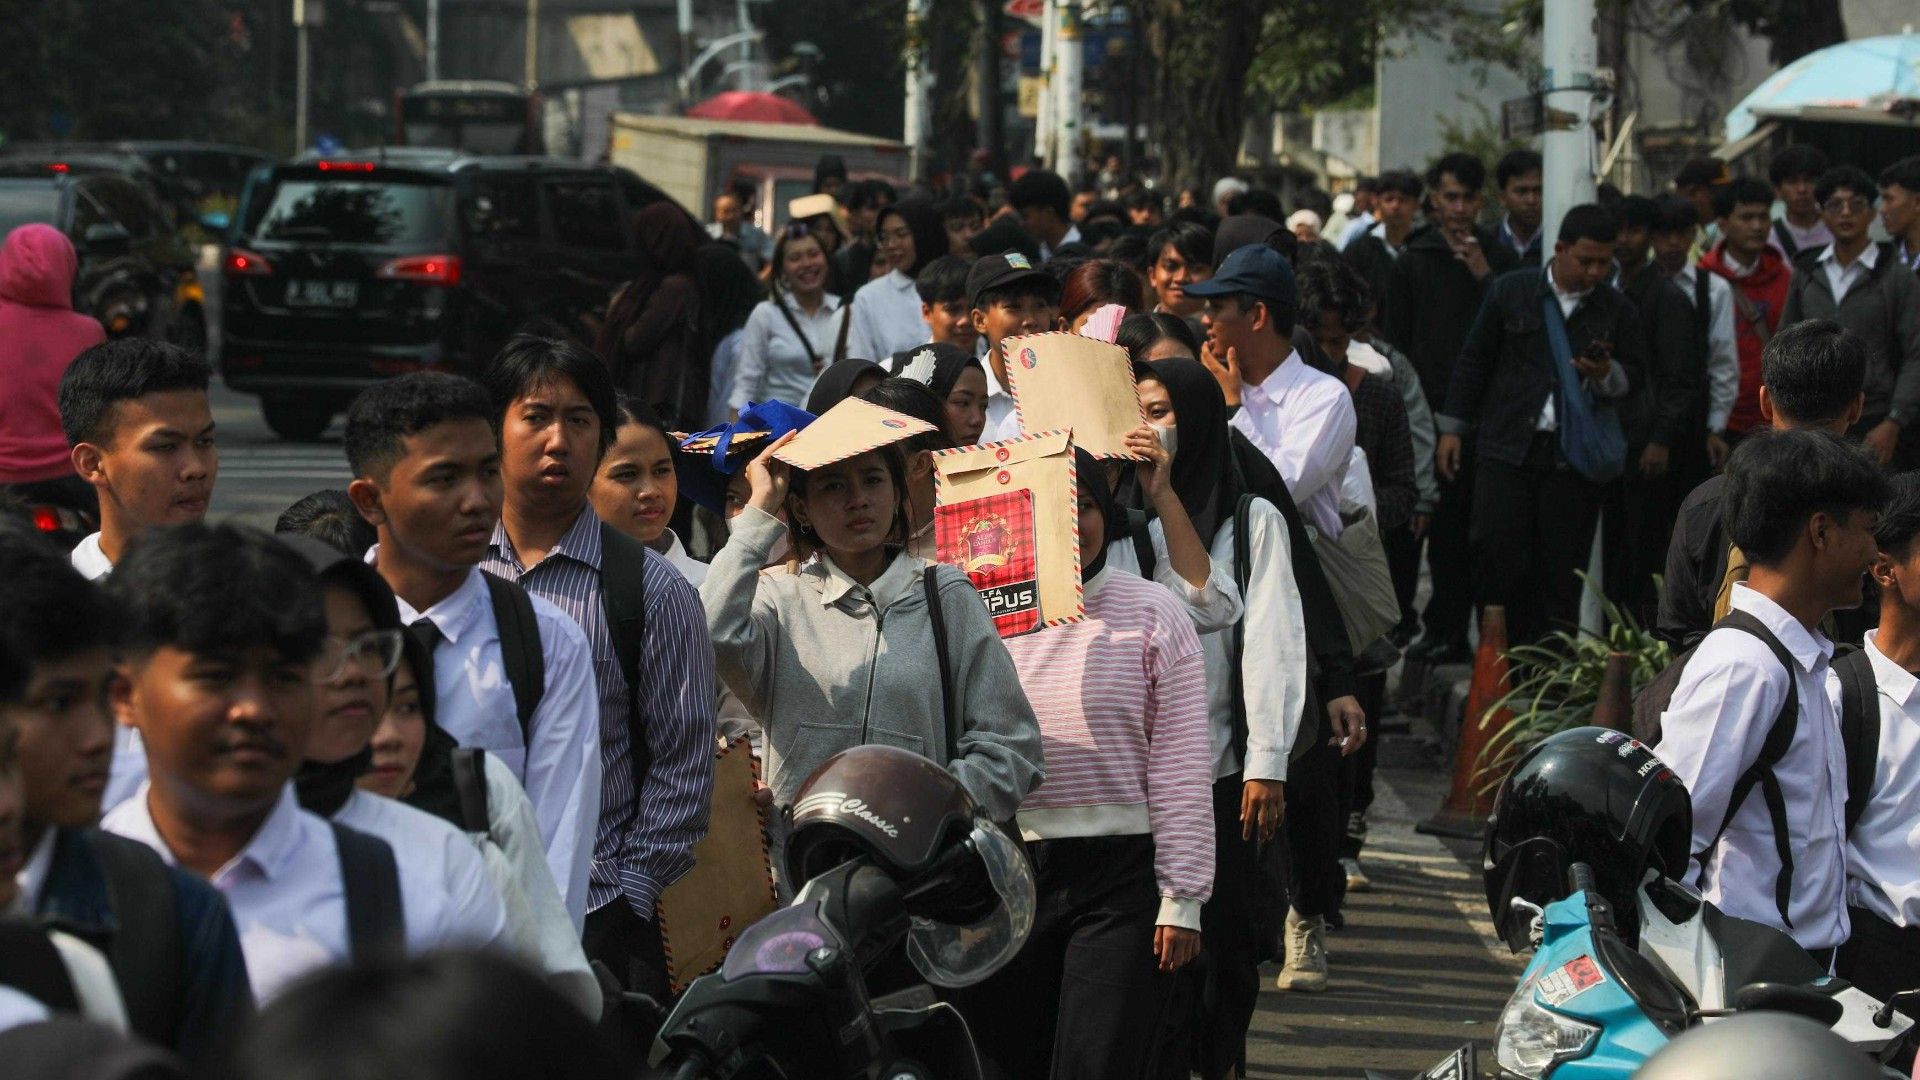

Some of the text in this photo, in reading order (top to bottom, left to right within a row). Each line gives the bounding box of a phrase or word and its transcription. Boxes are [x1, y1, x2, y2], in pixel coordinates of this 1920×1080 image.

[981, 588, 1002, 599] LFA
[984, 590, 1032, 612] PUS
[840, 799, 899, 838] Classic
